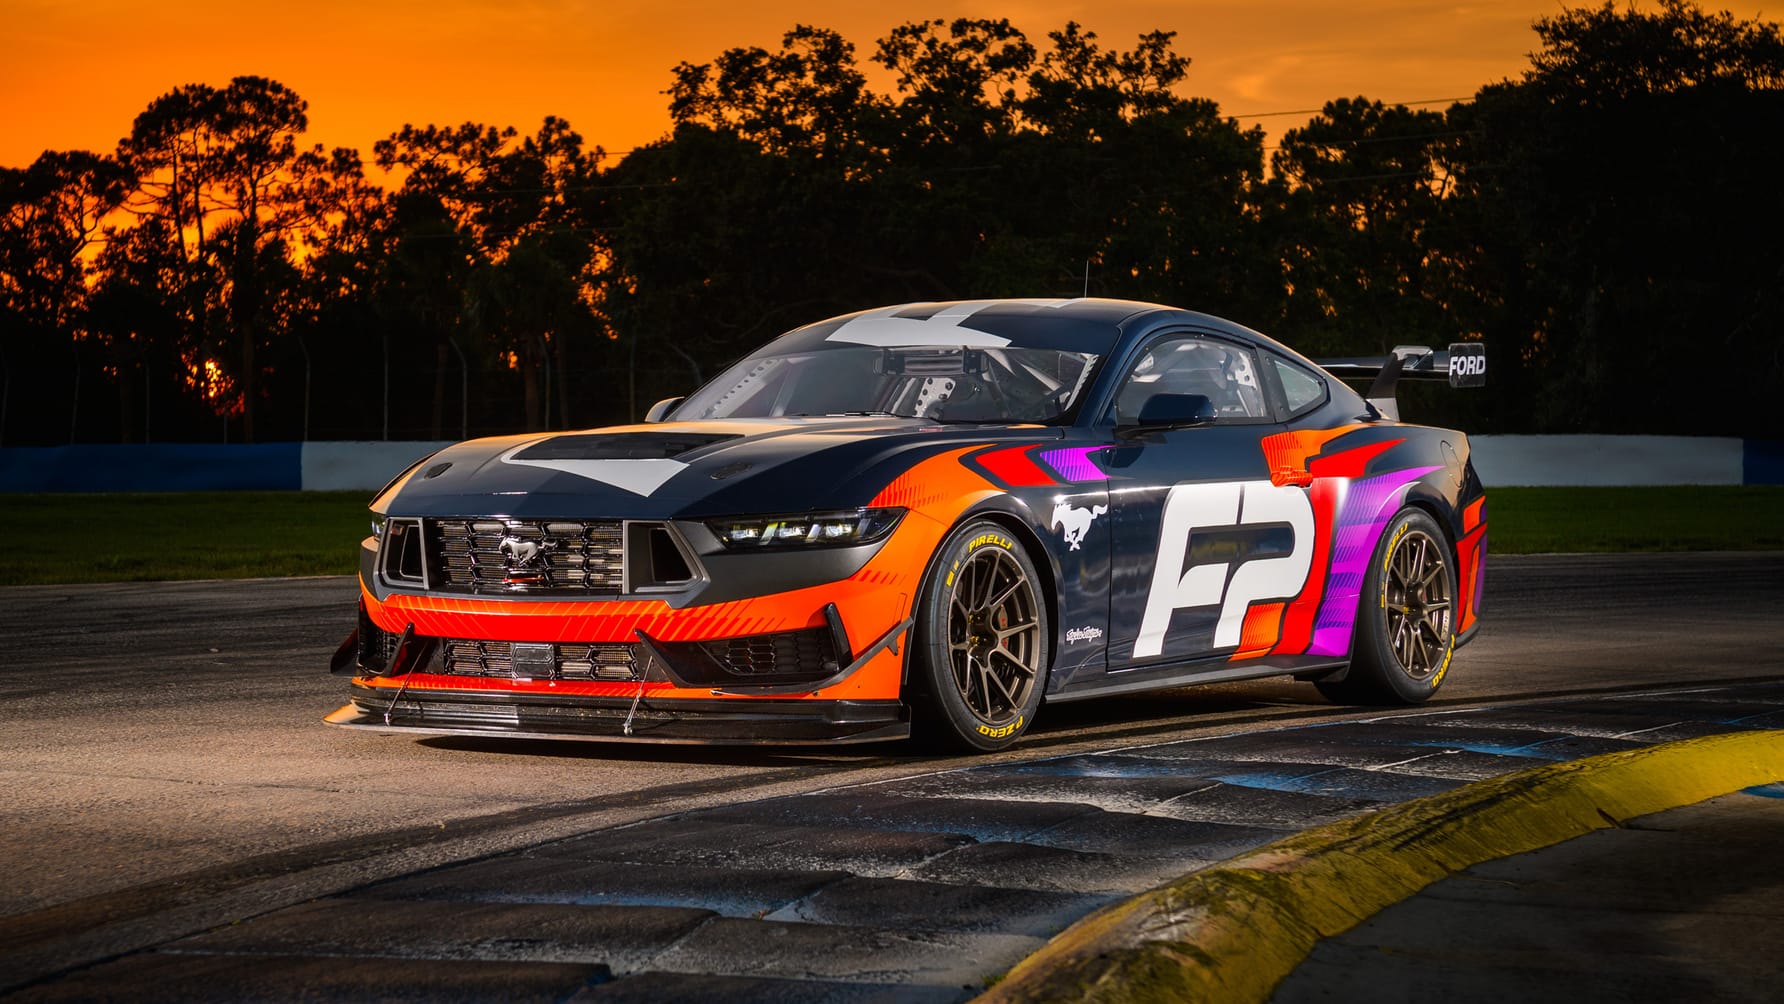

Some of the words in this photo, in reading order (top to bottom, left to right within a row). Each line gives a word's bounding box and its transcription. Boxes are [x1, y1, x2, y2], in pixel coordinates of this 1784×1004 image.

[1449, 355, 1486, 377] FORD
[968, 533, 1013, 553] PIRELLI
[1132, 480, 1316, 659] FP
